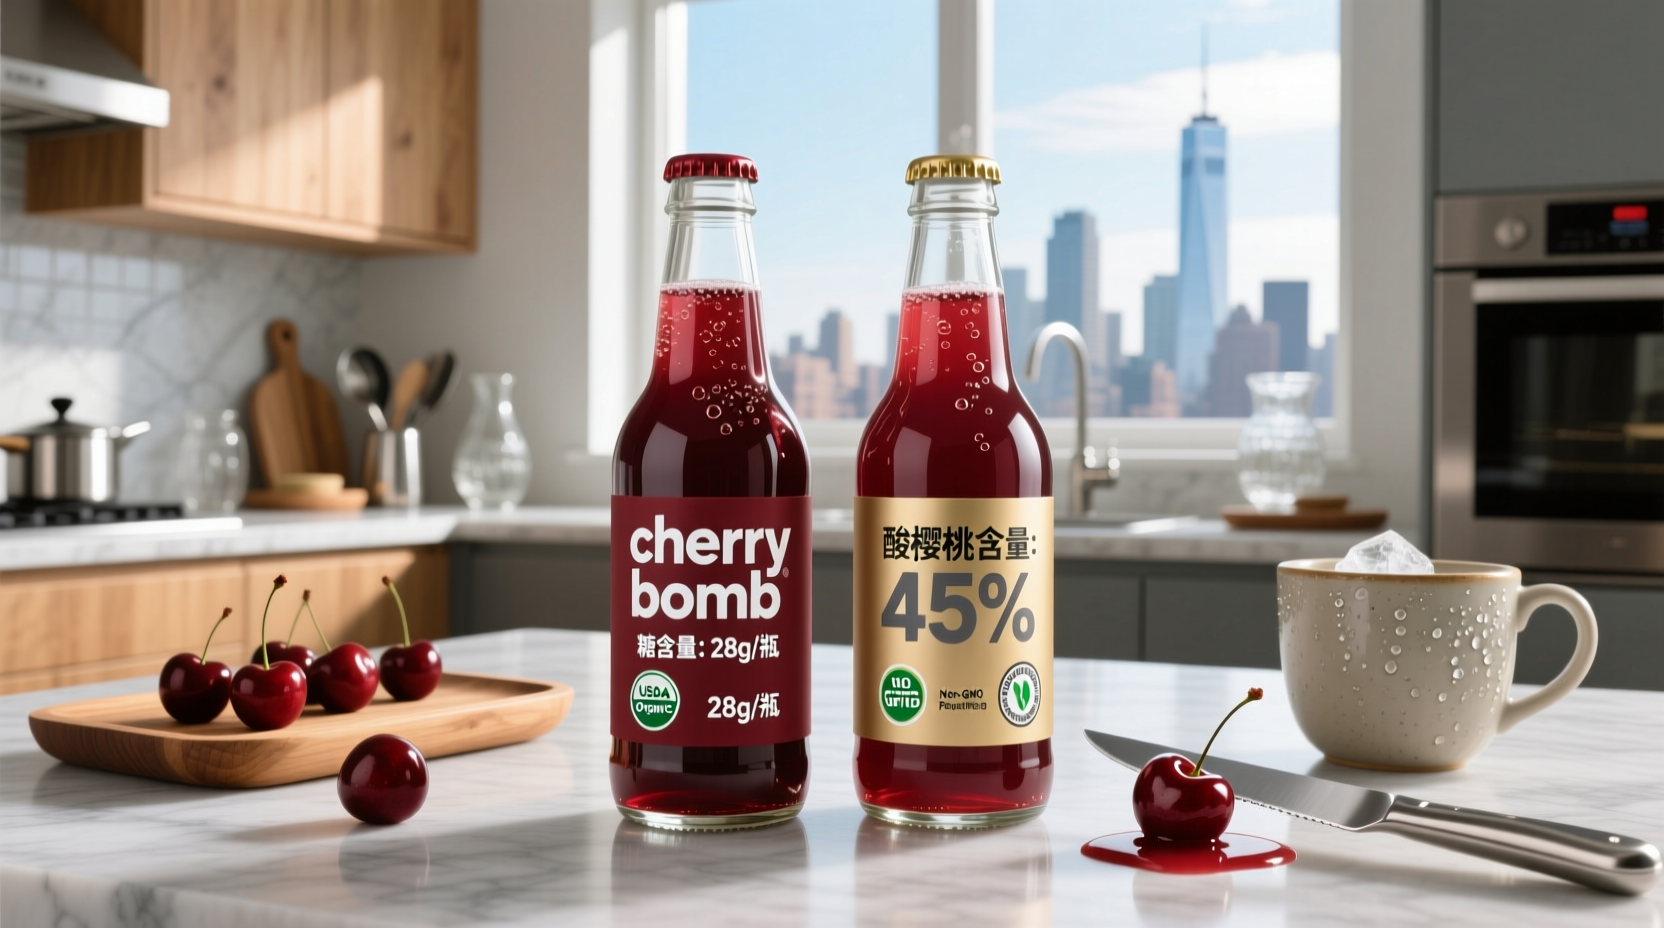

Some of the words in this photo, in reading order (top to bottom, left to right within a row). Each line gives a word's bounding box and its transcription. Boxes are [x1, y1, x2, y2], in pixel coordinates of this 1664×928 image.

[630, 515, 791, 577] cherry
[883, 525, 1036, 561] 酸樱桃含量:
[632, 568, 781, 619] bomb
[881, 572, 1035, 644] 45%
[639, 685, 670, 698] USDA
